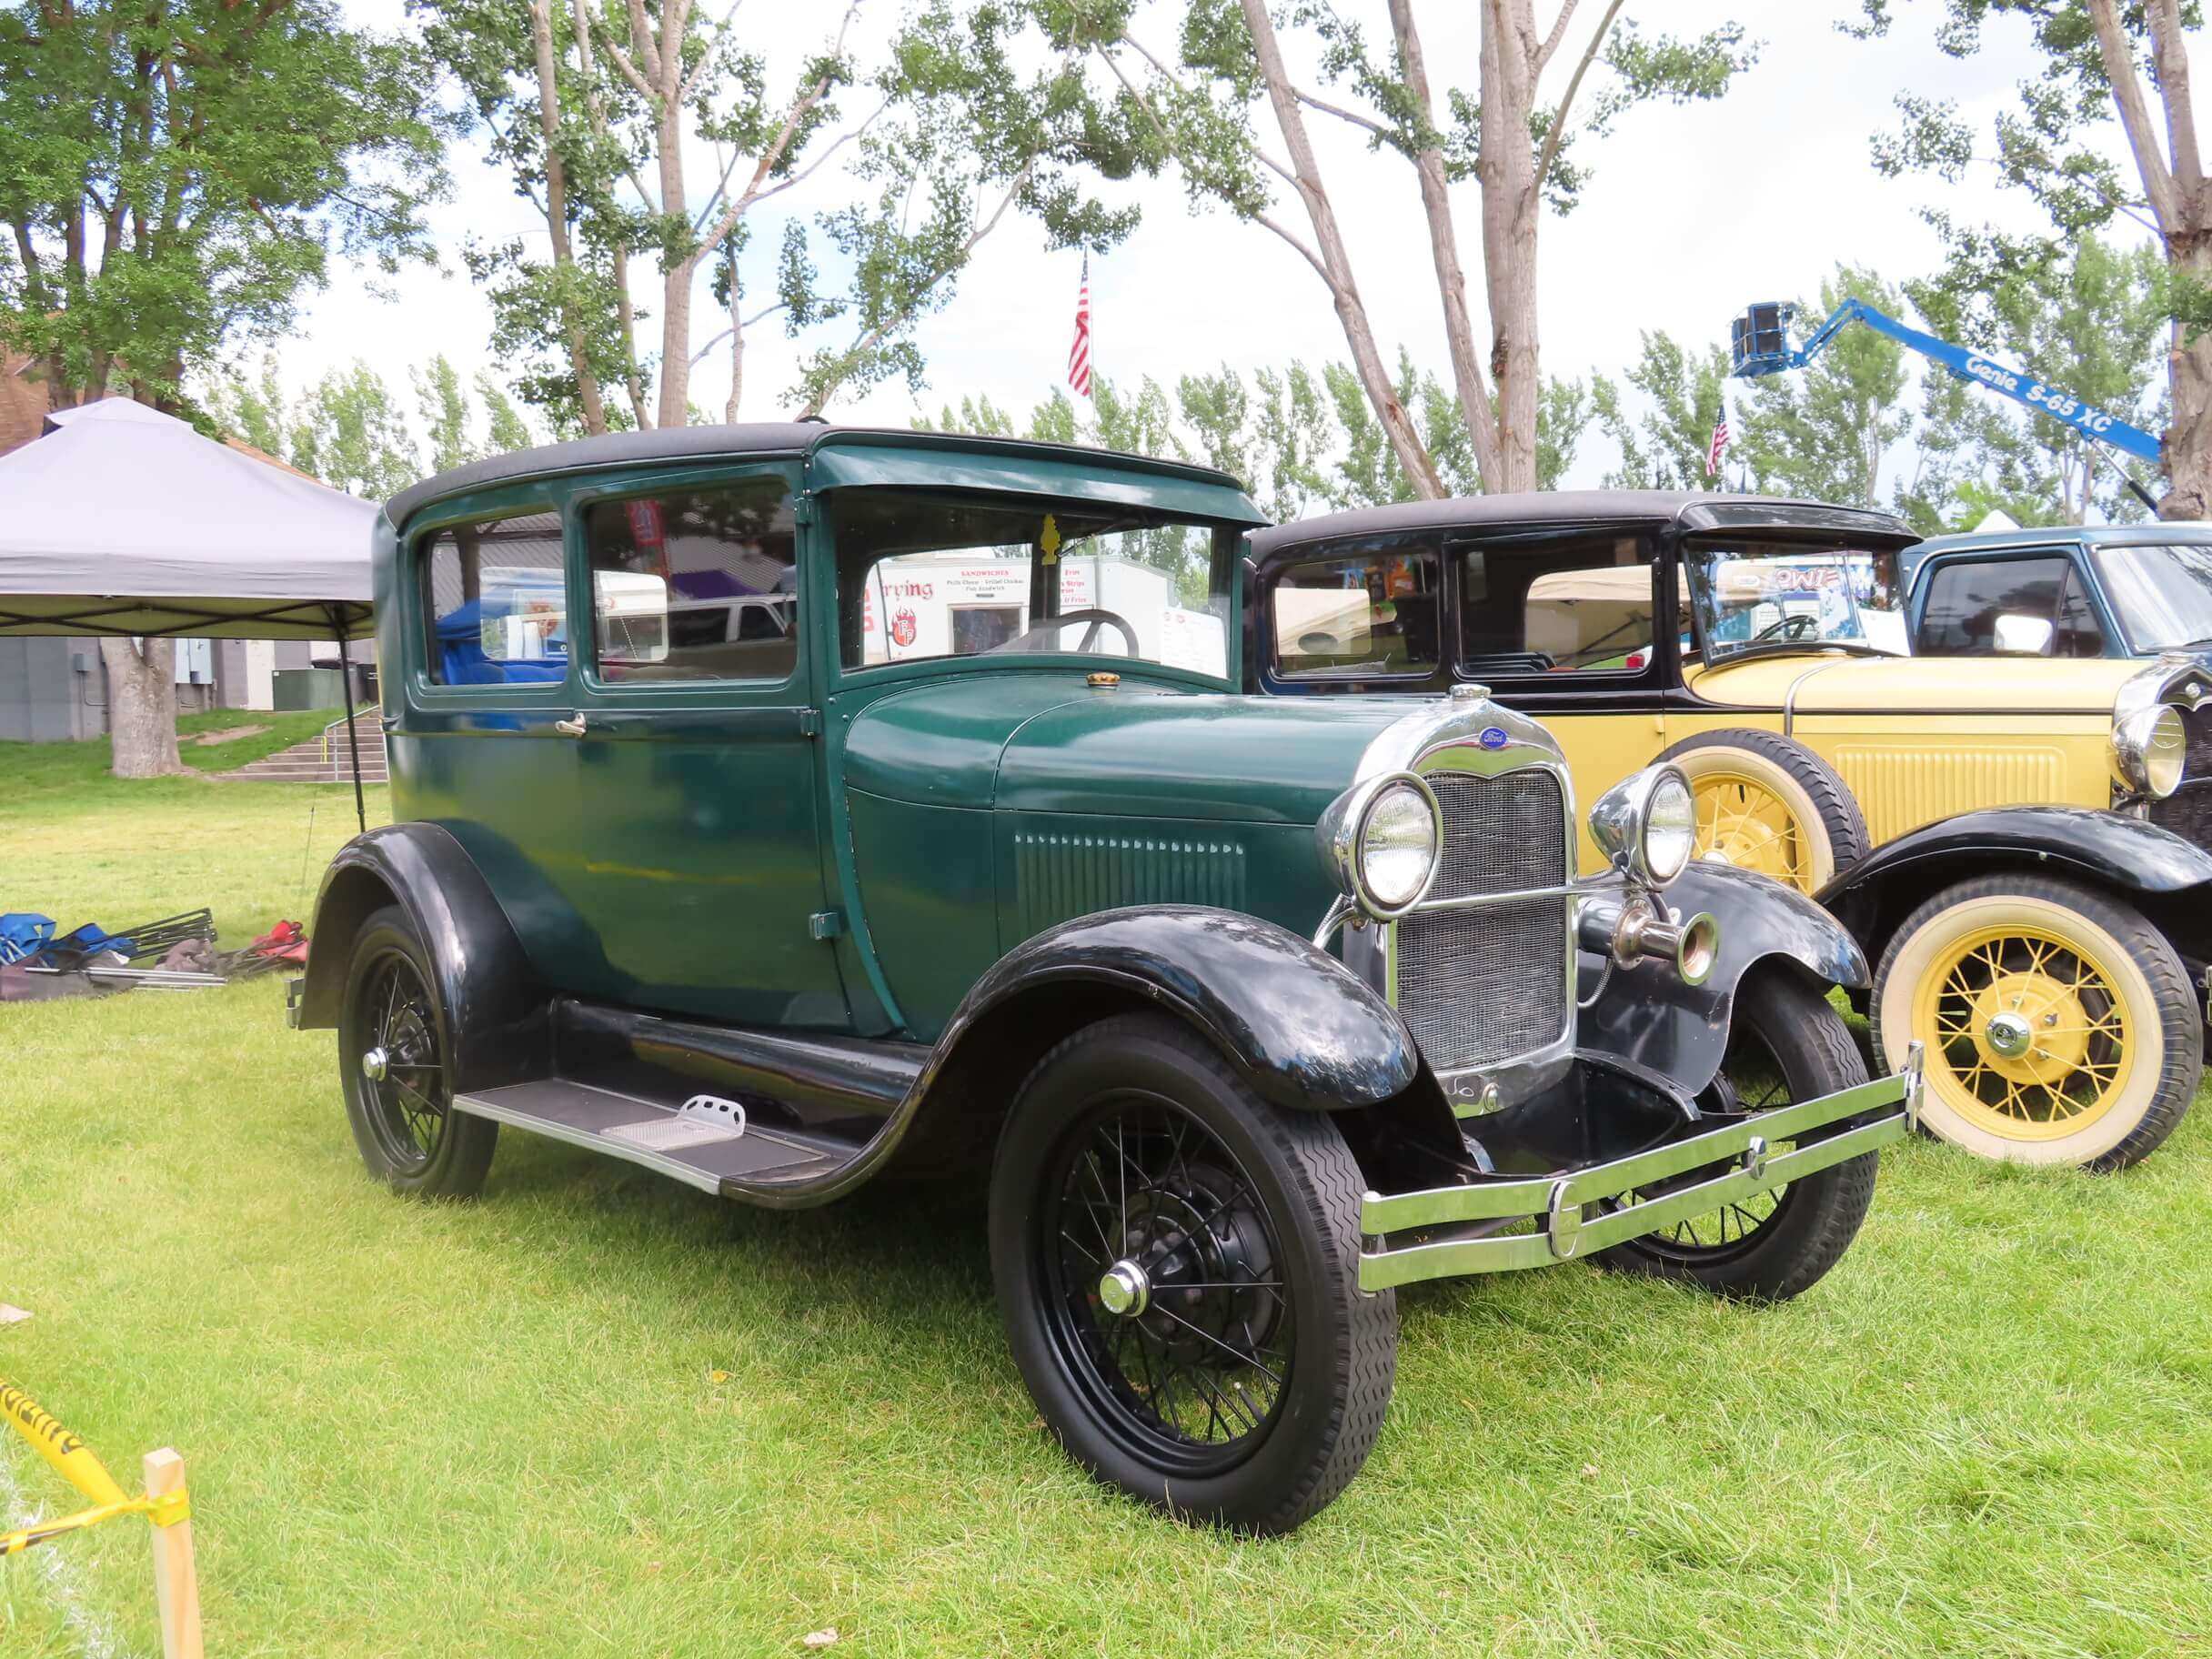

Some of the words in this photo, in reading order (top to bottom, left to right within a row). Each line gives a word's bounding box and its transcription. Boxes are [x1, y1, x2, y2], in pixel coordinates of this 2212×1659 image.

[1965, 355, 2018, 392] Genie
[2026, 385, 2079, 417] S-65
[2076, 407, 2112, 432] XC
[883, 579, 933, 600] rying
[1483, 730, 1503, 743] Ford
